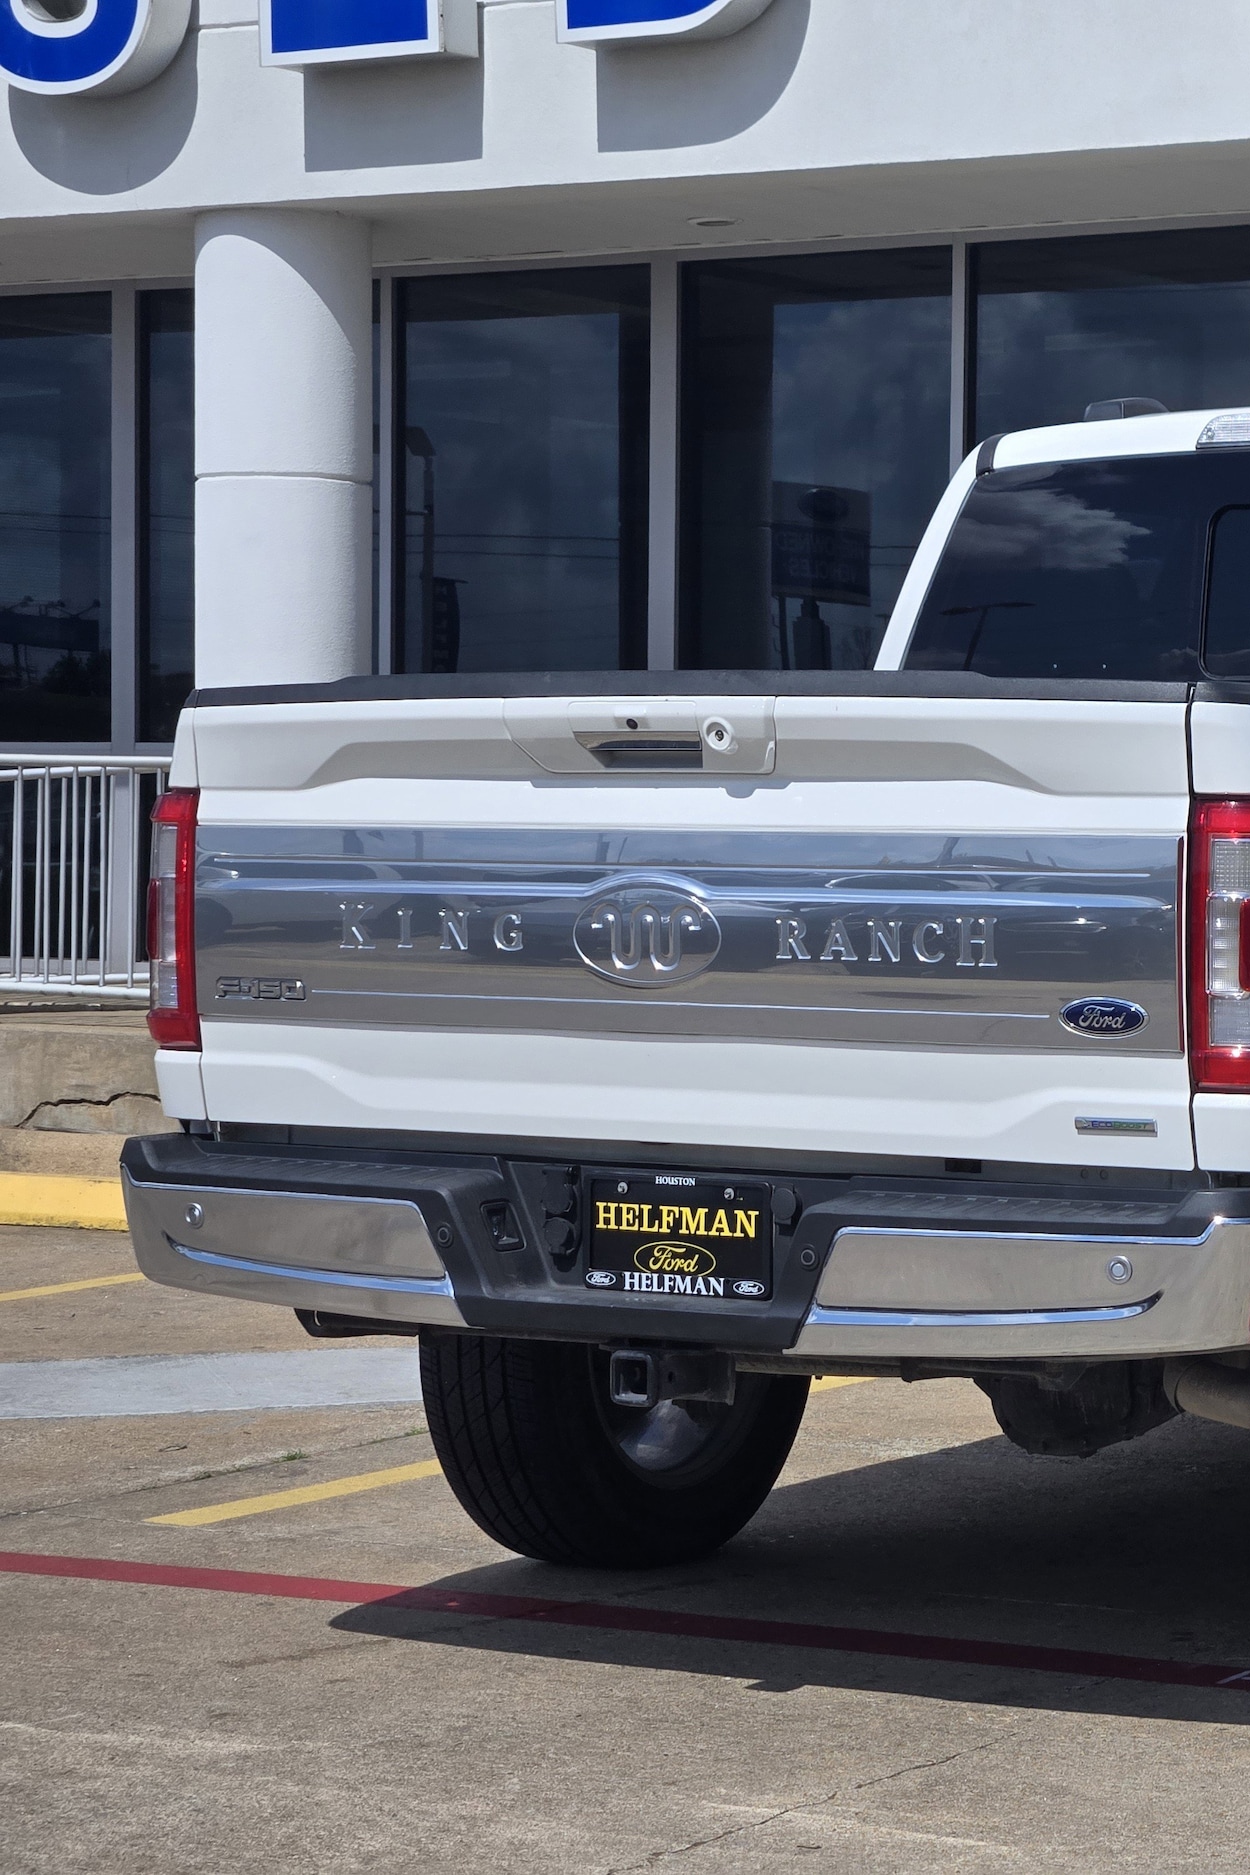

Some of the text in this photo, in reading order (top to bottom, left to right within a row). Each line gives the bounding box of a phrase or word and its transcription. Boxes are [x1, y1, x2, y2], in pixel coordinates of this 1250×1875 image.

[339, 900, 998, 967] KING RANCH
[215, 976, 307, 1001] F-150
[1077, 1004, 1126, 1029] Ford
[655, 1175, 696, 1187] HOUSTON
[595, 1201, 760, 1238] HELFMAN
[648, 1244, 699, 1273] Ford
[622, 1271, 725, 1296] HELFMAN
